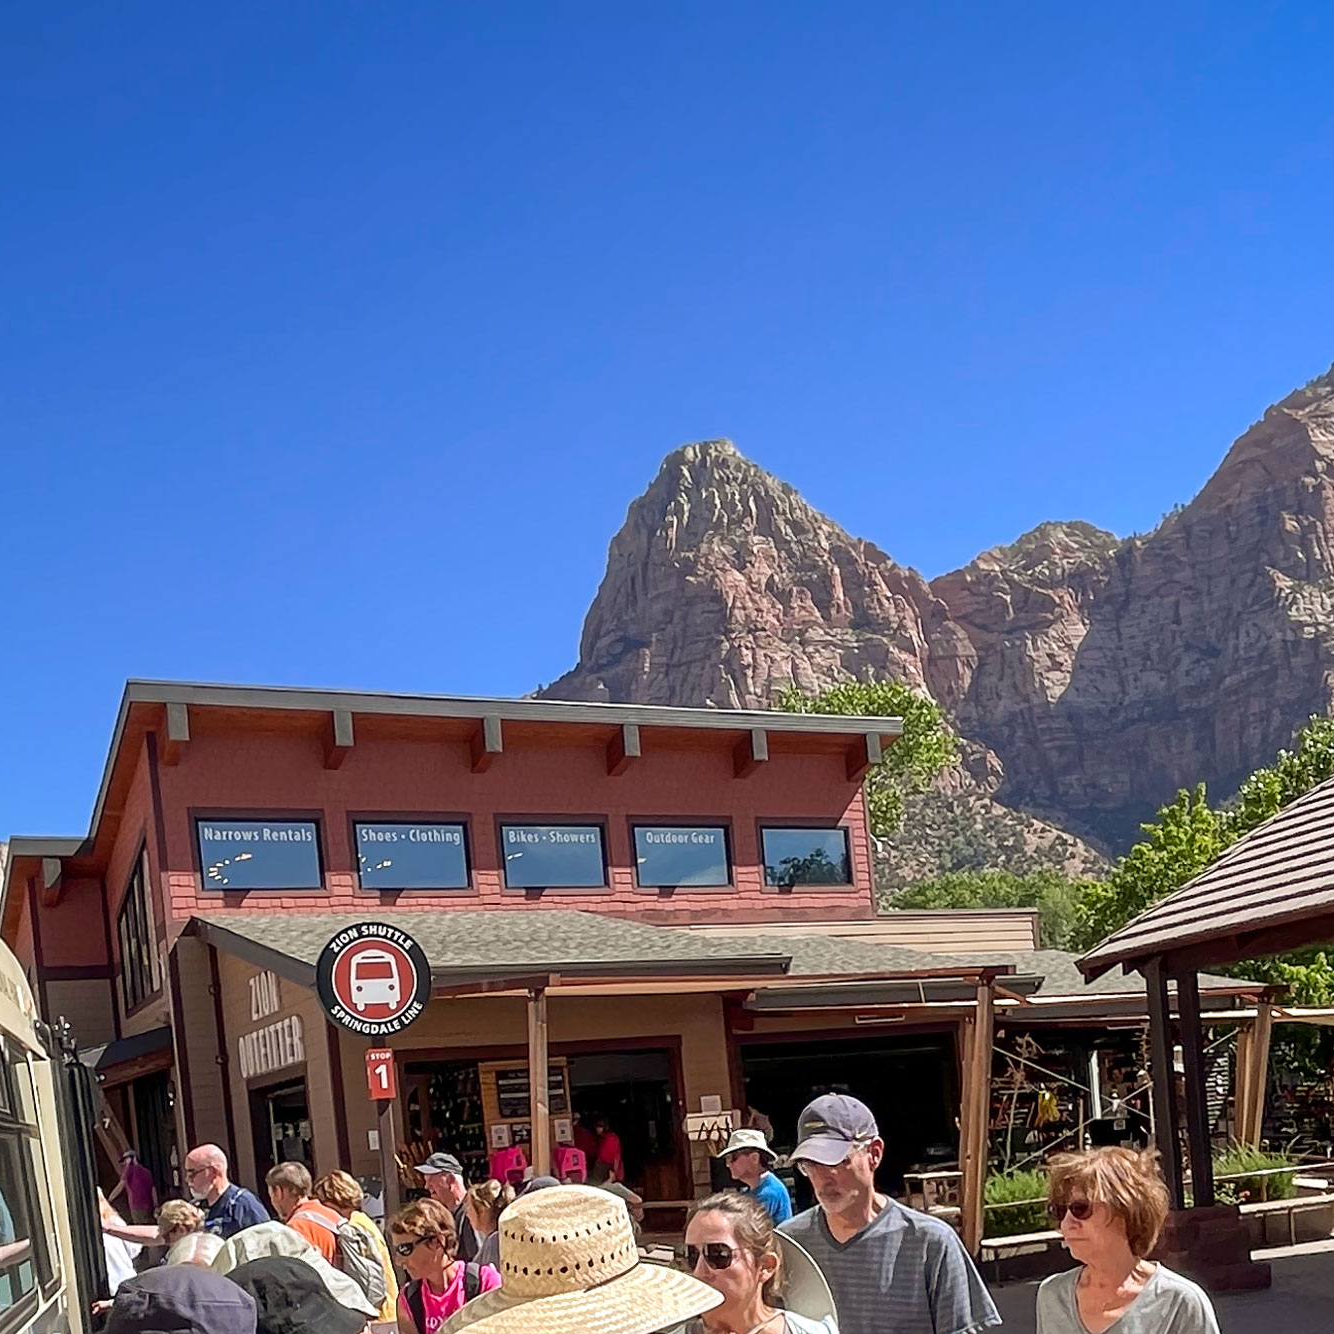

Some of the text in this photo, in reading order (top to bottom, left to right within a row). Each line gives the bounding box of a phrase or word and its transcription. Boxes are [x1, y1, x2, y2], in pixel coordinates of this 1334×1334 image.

[203, 827, 313, 843] Narrows Rentals
[361, 829, 461, 845] Shoes Clothing
[508, 830, 597, 844] Bikes Showers
[646, 832, 716, 845] Outdoor Gear
[329, 925, 414, 953] ZION SHUTTLE
[249, 970, 280, 1021] ZION
[330, 1000, 423, 1035] SPRINGDALE LINE
[239, 1015, 305, 1078] OUTFITTER
[370, 1052, 392, 1061] STOP
[375, 1064, 389, 1089] 1
